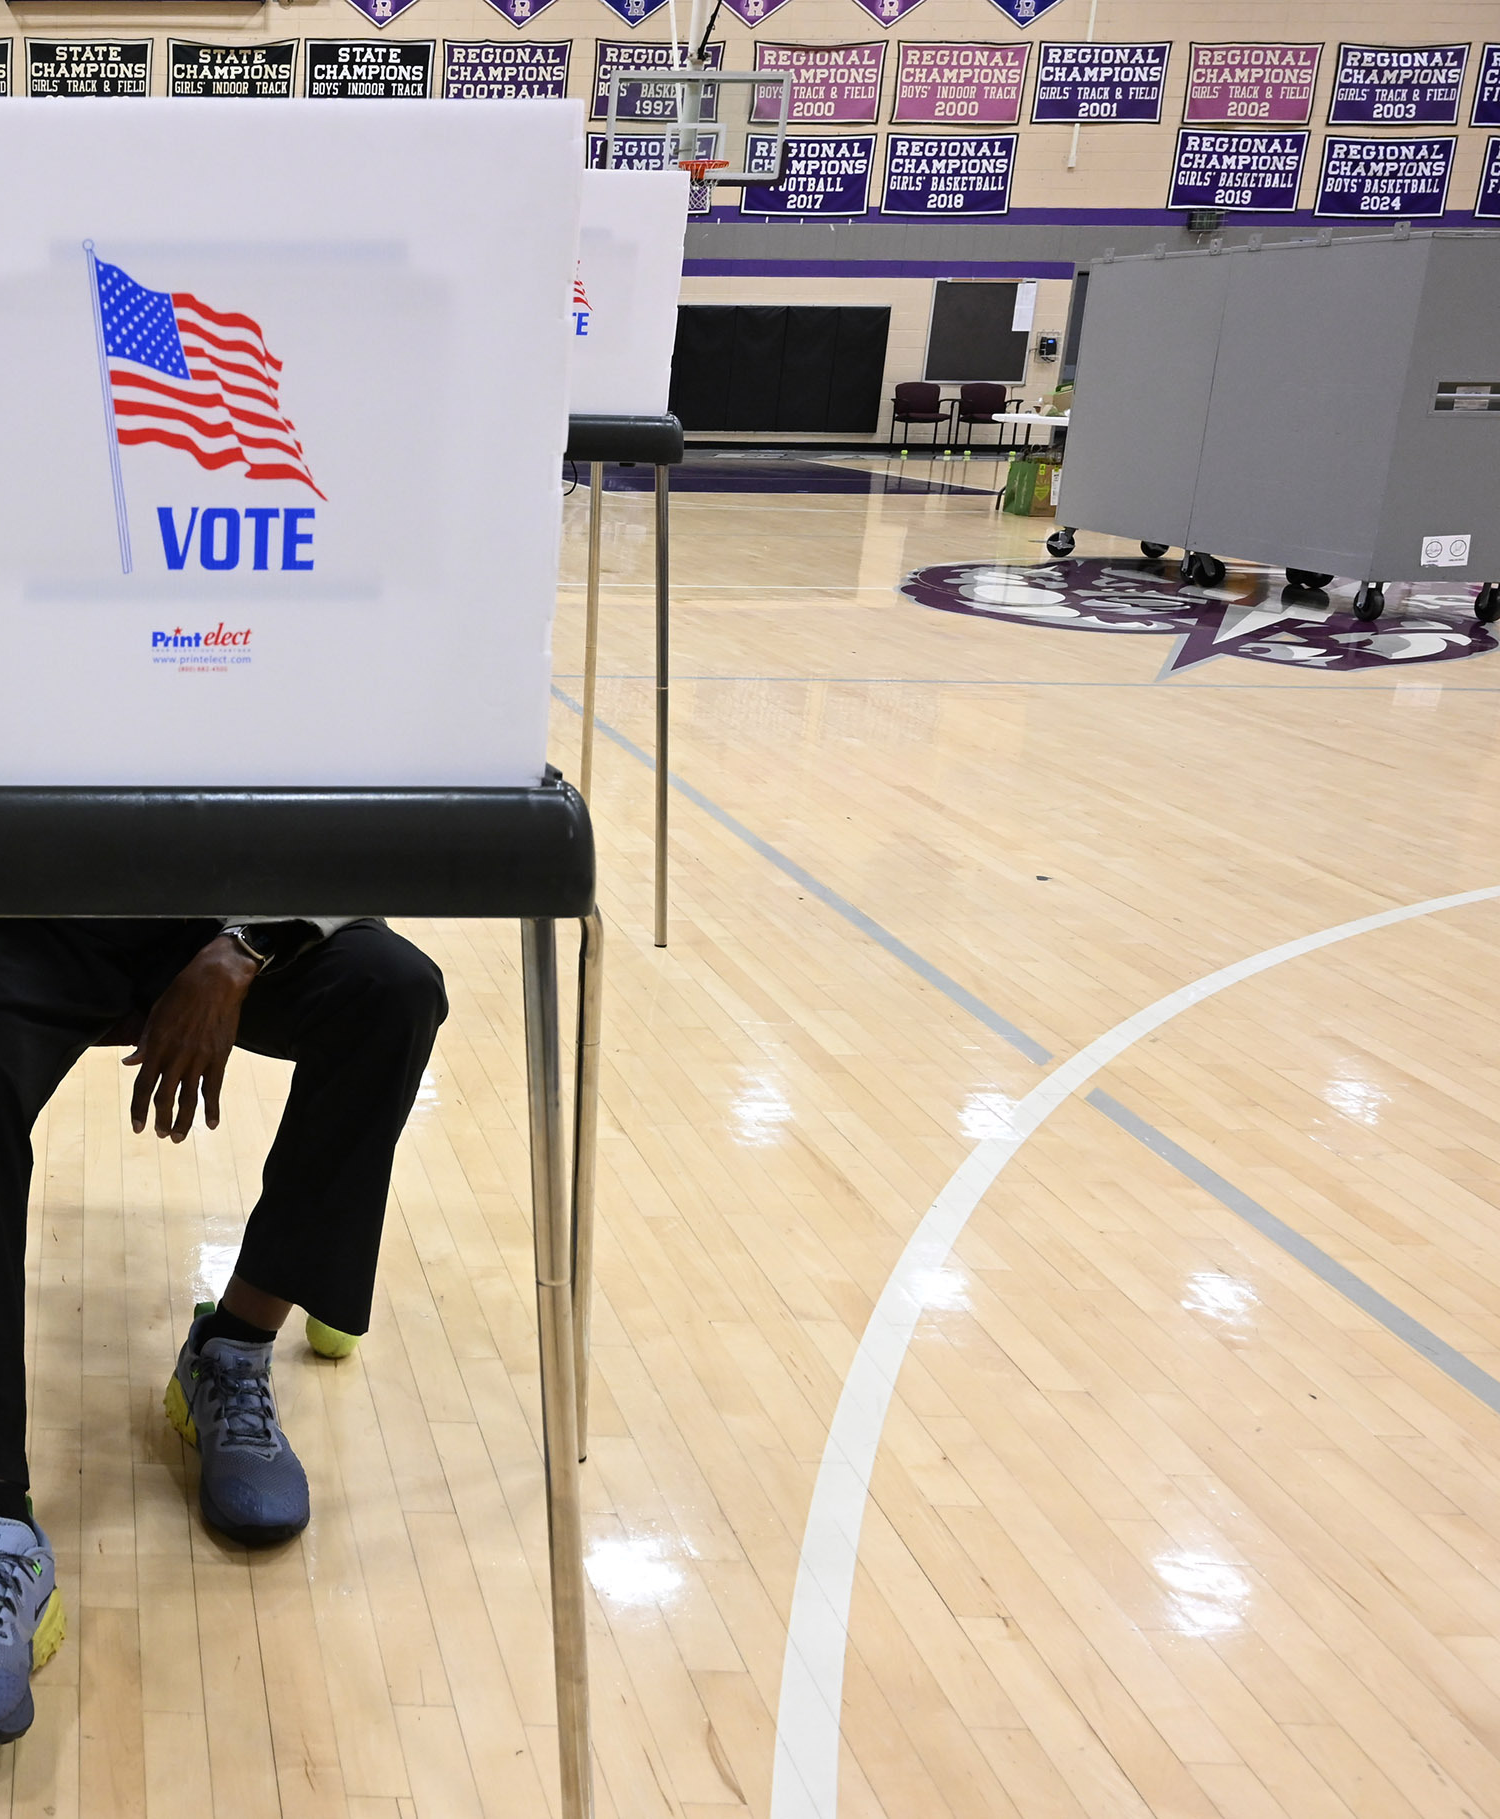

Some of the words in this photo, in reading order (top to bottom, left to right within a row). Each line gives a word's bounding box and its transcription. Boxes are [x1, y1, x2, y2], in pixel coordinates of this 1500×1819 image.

[56, 46, 121, 61] STATE
[199, 49, 266, 64] STATE
[338, 48, 401, 63] STATE
[453, 48, 560, 64] REGIONAL
[763, 50, 875, 65] REGIONAL
[906, 49, 1019, 66] REGIONAL
[1047, 48, 1159, 64] REGIONAL
[1198, 50, 1311, 65] REGIONAL
[1346, 51, 1457, 67] REGIONAL
[31, 63, 145, 78] CHAMPIONS
[174, 64, 290, 79] CHAMPIONS
[314, 65, 423, 80] CHAMPIONS
[447, 66, 565, 81] CHAMPIONS
[901, 67, 1020, 83] CHAMPIONS
[1041, 66, 1161, 82] CHAMPIONS
[1193, 68, 1312, 84] CHAMPIONS
[1339, 68, 1461, 84] CHAMPIONS
[32, 80, 61, 93] GIRLS'
[67, 80, 101, 93] TRACK
[104, 80, 111, 93] &
[115, 80, 145, 93] FIELD
[175, 81, 208, 94] GIRLS'
[212, 81, 249, 95] INDOOR
[256, 81, 287, 95] TRACK
[313, 82, 343, 96] BOYS'
[348, 82, 385, 96] INDOOR
[391, 82, 423, 96] TRACK
[448, 84, 559, 99] FOOTBALL
[793, 87, 827, 98] TRACK
[831, 87, 837, 98] &
[844, 87, 874, 99] FIELD
[901, 85, 931, 99] BOYS'
[937, 85, 977, 99] INDOOR
[984, 85, 1017, 99] TRACK
[1040, 86, 1073, 100] GIRLS'
[1077, 86, 1111, 99] TRACK
[1115, 86, 1123, 99] &
[1129, 86, 1158, 100] FIELD
[1191, 85, 1223, 99] GIRLS'
[1229, 85, 1262, 98] TRACK
[1266, 85, 1273, 98] &
[1280, 86, 1309, 99] FIELD
[1338, 88, 1369, 101] GIRLS'
[1375, 88, 1409, 101] TRACK
[1413, 89, 1421, 101] &
[1427, 89, 1457, 101] FIELD
[635, 100, 674, 115] 1997
[793, 102, 835, 116] 2000
[934, 101, 979, 116] 2000
[1078, 102, 1118, 117] 2001
[1227, 102, 1270, 117] 2002
[1372, 104, 1416, 119] 2003
[896, 141, 1007, 157] REGIONAL
[1186, 136, 1297, 153] REGIONAL
[1332, 144, 1444, 160] REGIONAL
[890, 157, 1008, 173] CHAMPIONS
[1180, 154, 1297, 170] CHAMPIONS
[1326, 161, 1445, 177] CHAMPIONS
[890, 175, 926, 190] GIRLS'
[931, 175, 1004, 191] BASKETBALL
[1178, 172, 1215, 187] GIRLS'
[1219, 172, 1293, 188] BASKETBALL
[1325, 179, 1362, 193] BOYS'
[1364, 179, 1440, 194] BASKETBALL
[787, 194, 823, 209] 2017
[926, 193, 964, 208] 2018
[1214, 189, 1252, 205] 2019
[1360, 196, 1401, 211] 2024
[157, 507, 315, 570] VOTE
